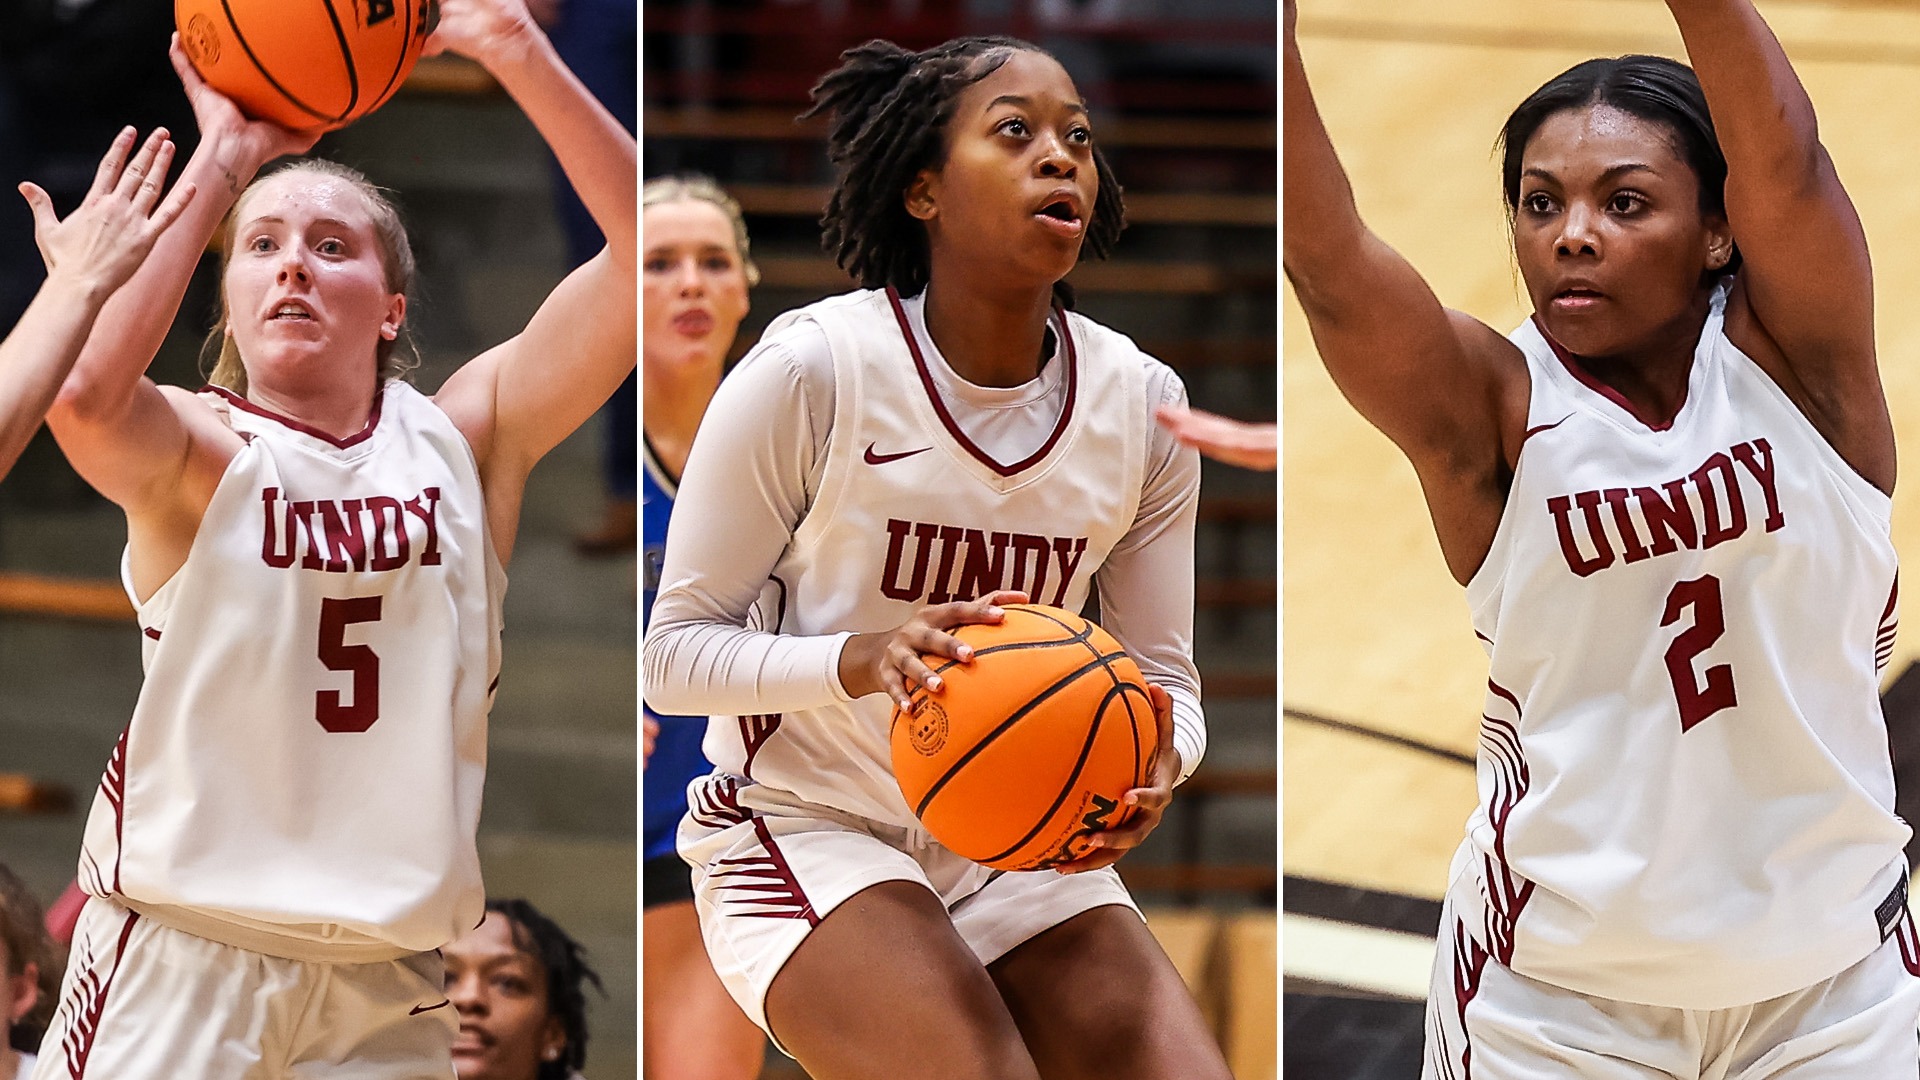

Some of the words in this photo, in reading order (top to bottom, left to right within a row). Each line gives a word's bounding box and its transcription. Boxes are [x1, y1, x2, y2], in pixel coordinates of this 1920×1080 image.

[261, 486, 442, 573] UINDY
[880, 518, 1089, 609] UINDY
[1546, 437, 1786, 578] UINDY
[315, 595, 384, 733] 5
[1659, 573, 1738, 735] 2
